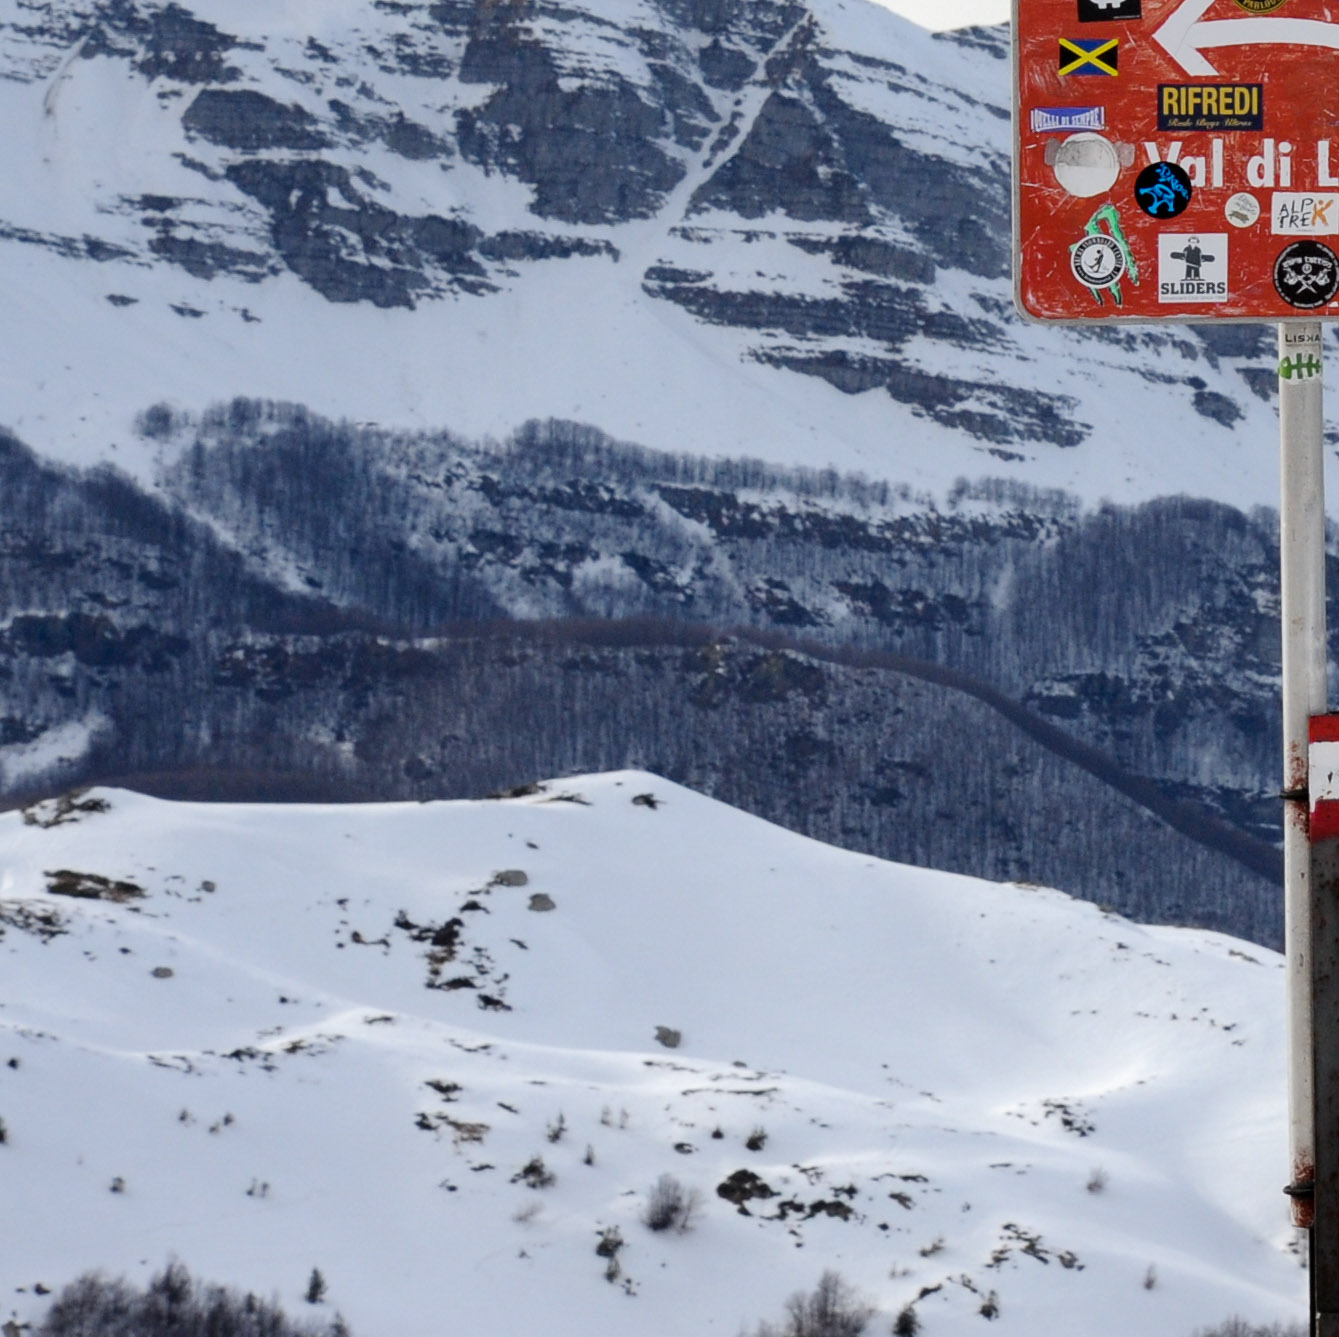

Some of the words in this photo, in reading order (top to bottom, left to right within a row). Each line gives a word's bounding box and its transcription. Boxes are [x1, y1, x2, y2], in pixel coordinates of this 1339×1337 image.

[1162, 86, 1259, 116] RIFREDI
[1247, 138, 1292, 188] di
[1160, 282, 1226, 295] SLIDERS
